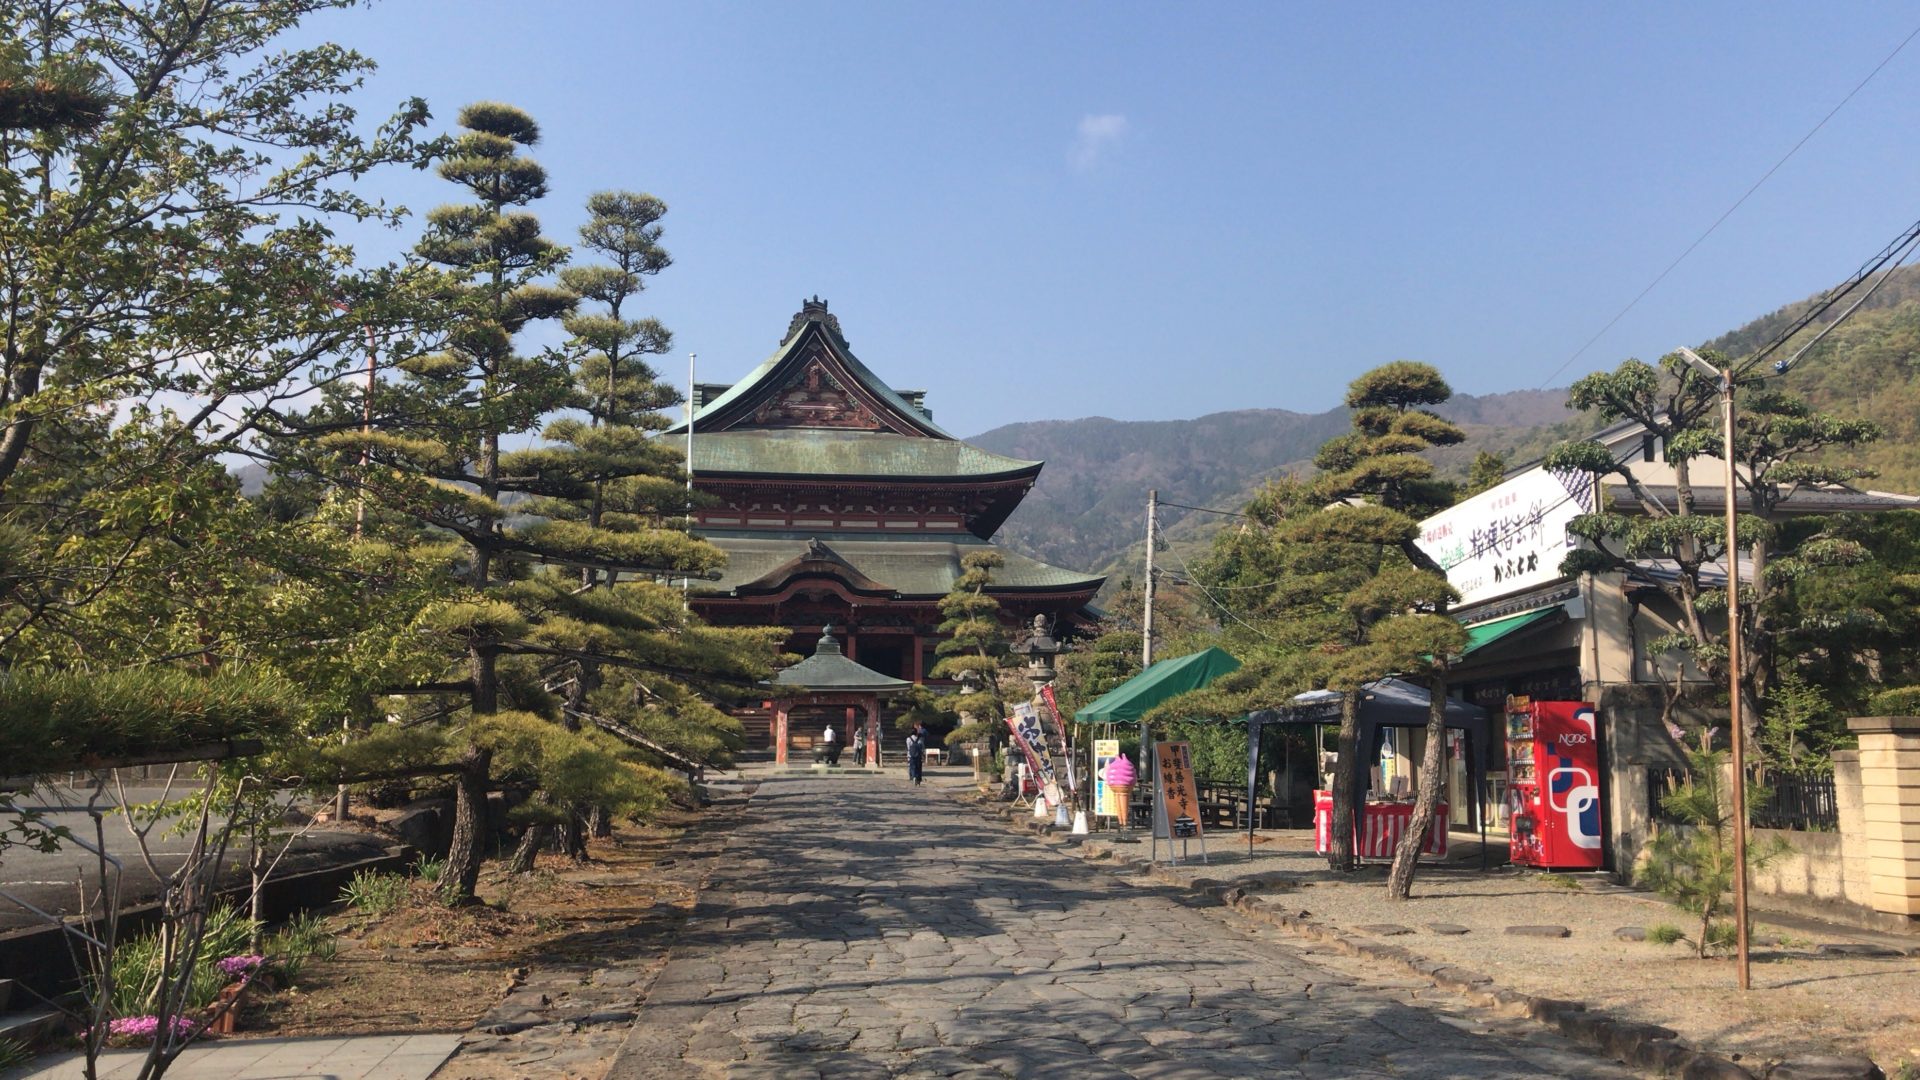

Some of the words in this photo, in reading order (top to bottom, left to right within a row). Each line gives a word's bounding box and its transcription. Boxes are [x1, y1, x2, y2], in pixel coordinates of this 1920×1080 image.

[1494, 550, 1538, 583] かぶとや
[1162, 757, 1177, 800] お線香
[1169, 744, 1188, 810] 甲斐善光寺
